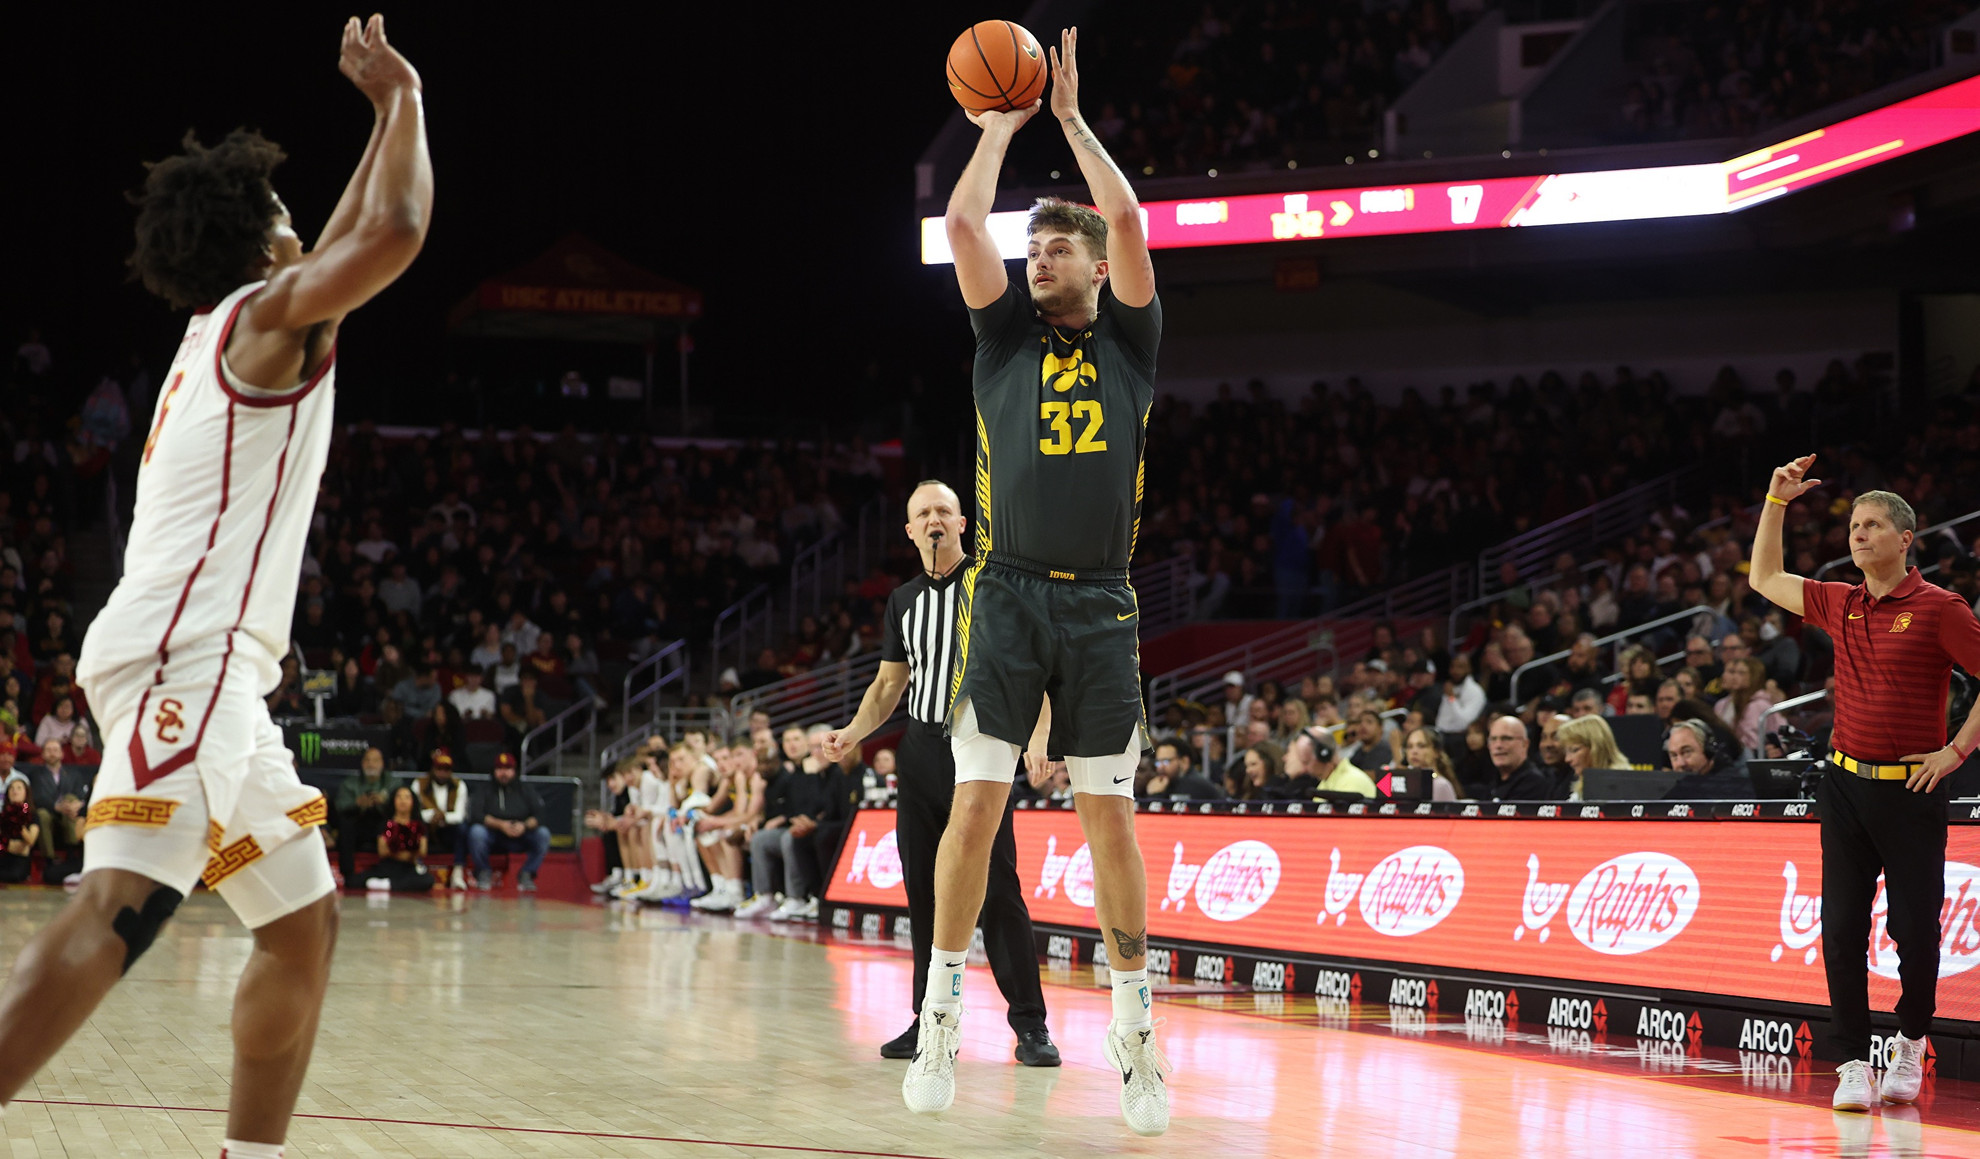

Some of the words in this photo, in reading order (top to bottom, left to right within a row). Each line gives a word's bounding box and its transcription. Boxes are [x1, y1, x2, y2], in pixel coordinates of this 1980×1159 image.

[501, 286, 548, 308] USC
[555, 288, 682, 313] ATHLETICS
[1039, 400, 1107, 455] 32
[1049, 570, 1075, 581] IOWA
[1731, 804, 1754, 817] ARCO
[1783, 803, 1808, 817] ARCO
[1366, 855, 1454, 929] Ralphs
[1574, 862, 1688, 948] Ralphs
[1047, 935, 1072, 960] ARCO
[1194, 955, 1225, 981] ARCO
[1252, 961, 1285, 991] ARCO
[1315, 969, 1350, 999] ARCO
[1389, 977, 1427, 1007] ARCO
[1464, 988, 1505, 1019] ARCO
[1547, 997, 1592, 1029] ARCO
[1637, 1006, 1686, 1042] ARCO
[1739, 1018, 1793, 1054] ARCO
